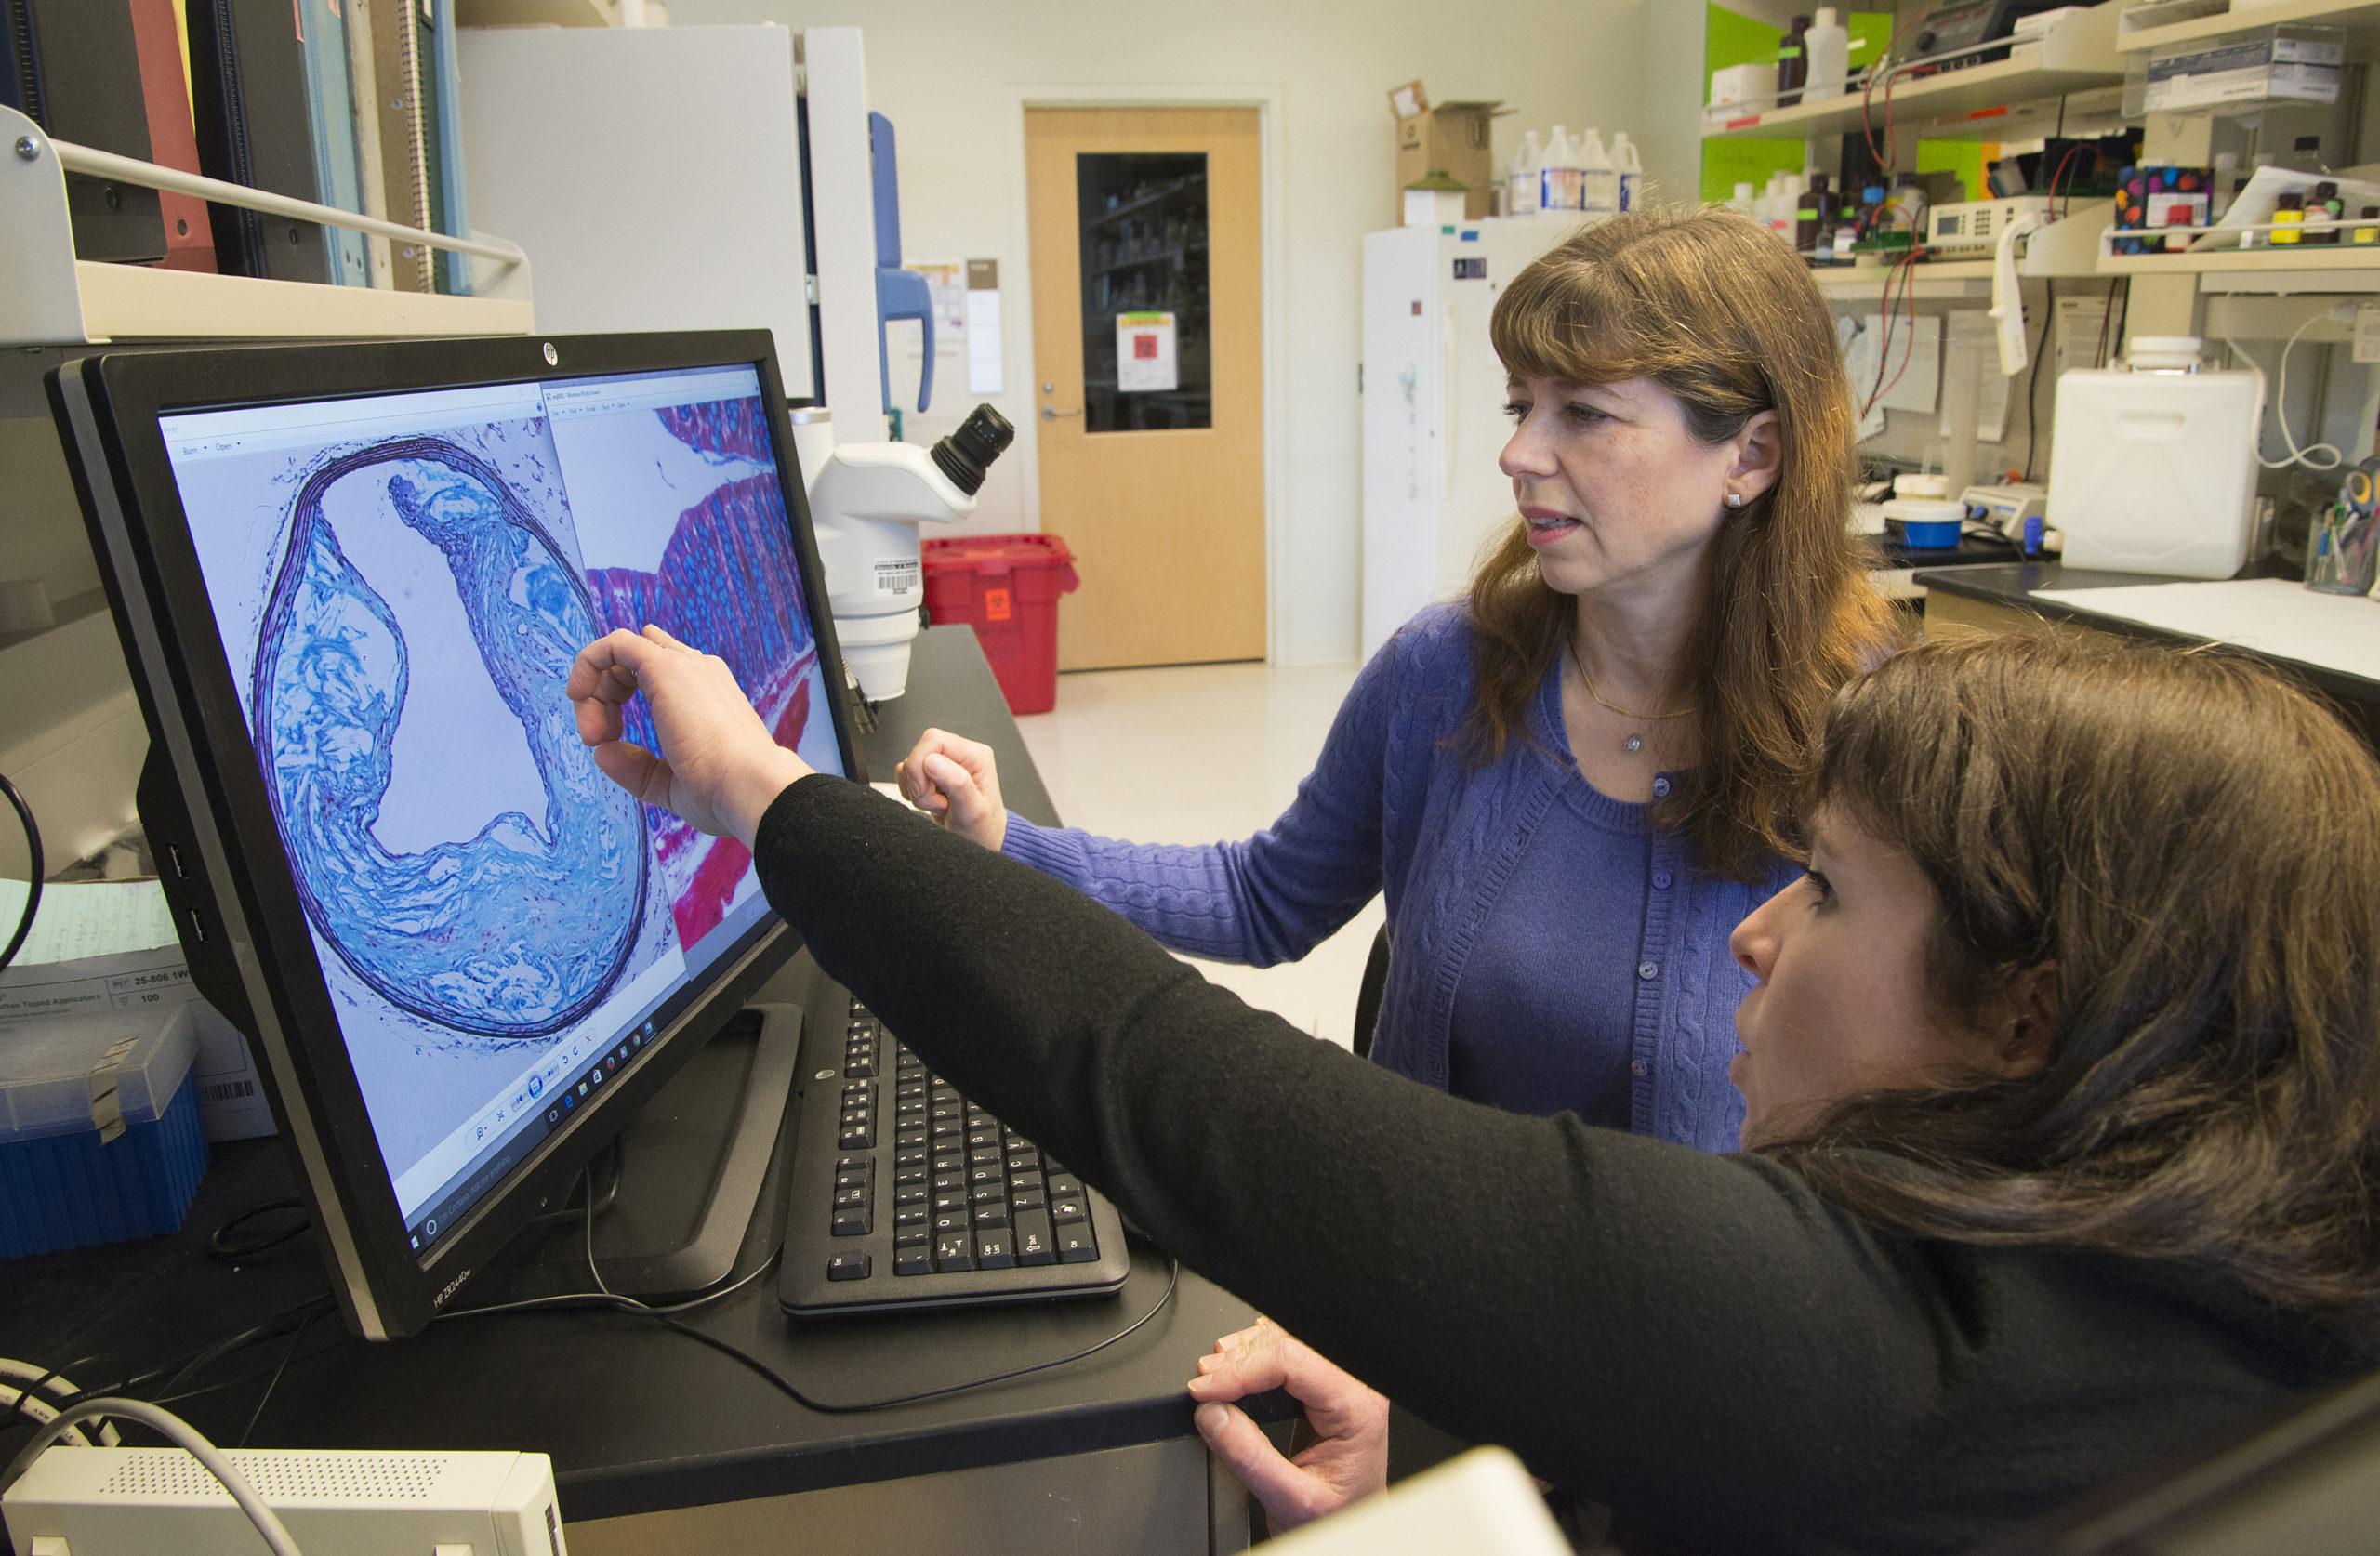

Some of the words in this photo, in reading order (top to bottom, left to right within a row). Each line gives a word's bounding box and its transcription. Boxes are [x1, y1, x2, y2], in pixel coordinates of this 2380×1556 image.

[135, 973, 169, 986] 25-806
[23, 999, 50, 1009] Tipped
[52, 993, 101, 1007] Applicators
[141, 993, 160, 1004] 100
[984, 1244, 992, 1256] Caps
[834, 1258, 842, 1266] Esc
[432, 1293, 443, 1309] HP
[443, 1268, 471, 1299] ZR2440w
[33, 1407, 51, 1420] AWM
